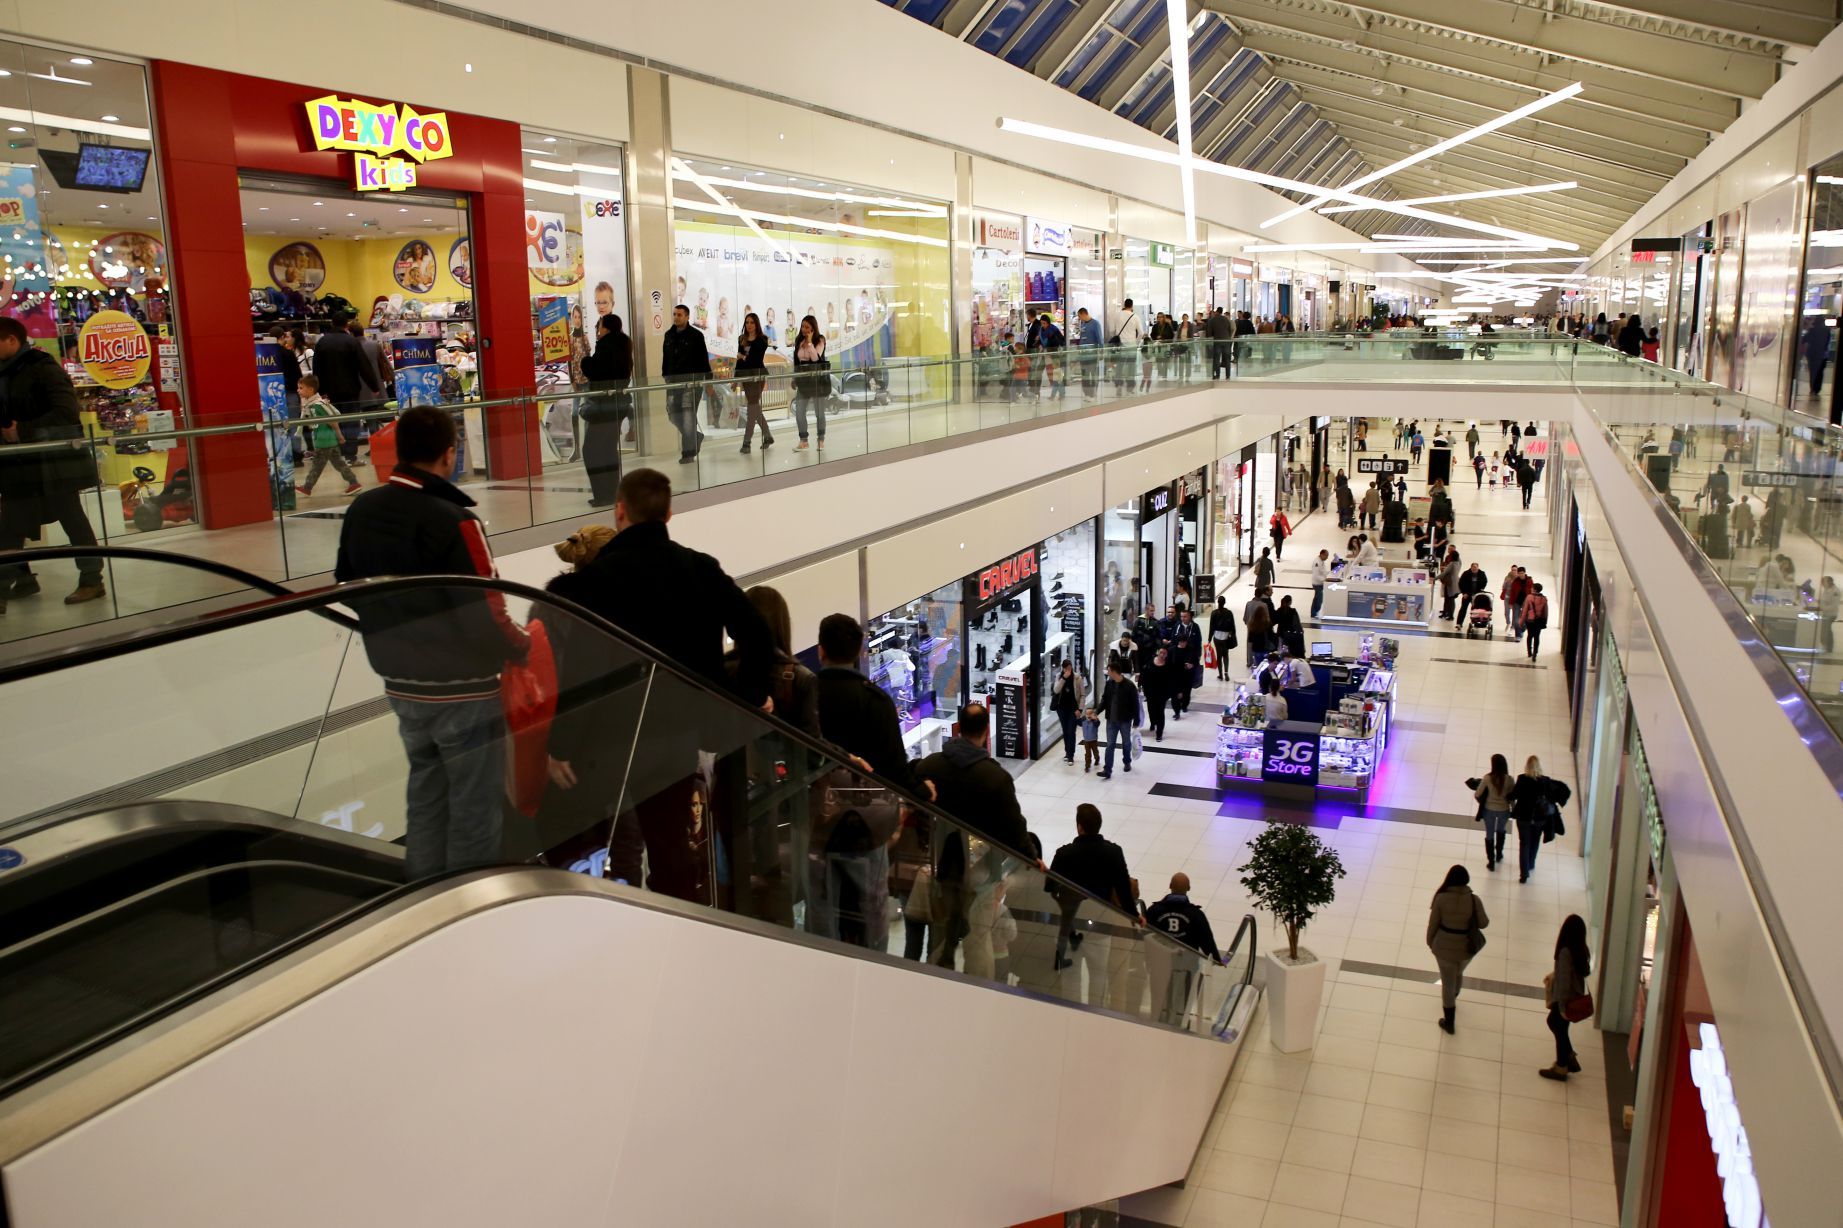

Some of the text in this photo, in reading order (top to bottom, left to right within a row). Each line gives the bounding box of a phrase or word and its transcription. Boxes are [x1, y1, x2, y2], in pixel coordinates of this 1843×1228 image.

[317, 104, 444, 152] DEXY CO
[360, 158, 414, 186] kids
[84, 332, 148, 363] AKCIJA
[402, 348, 431, 360] CHIMA
[256, 354, 276, 367] IMA
[979, 548, 1037, 600] CARVEL
[1270, 740, 1315, 763] 3G
[1265, 759, 1312, 776] Store
[1168, 918, 1180, 932] B
